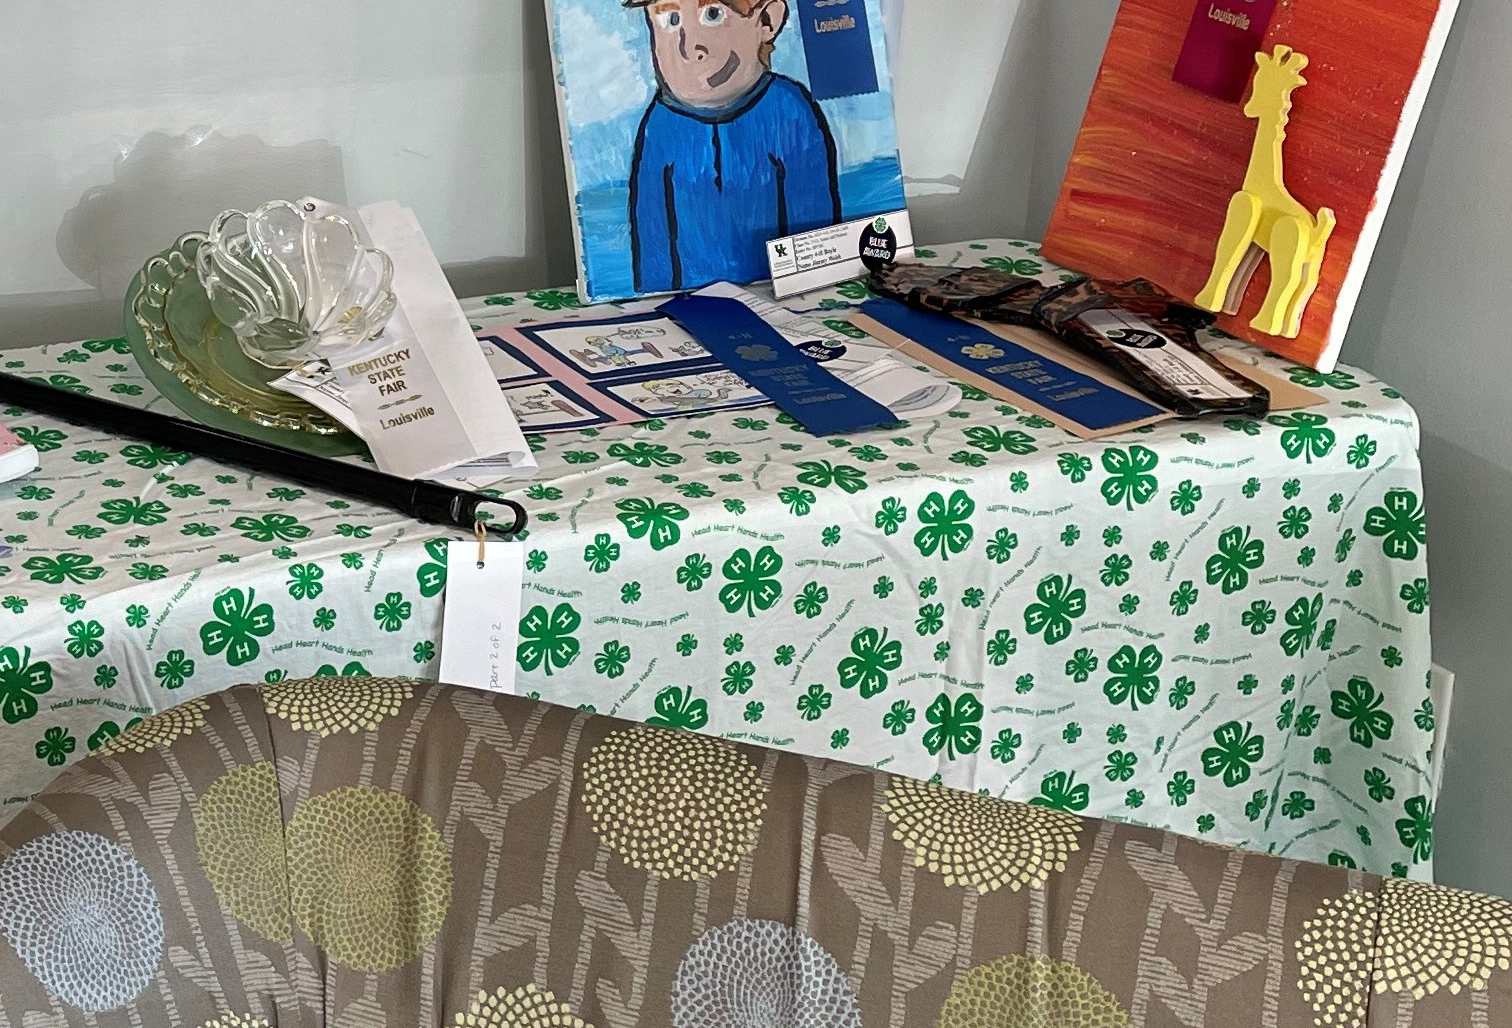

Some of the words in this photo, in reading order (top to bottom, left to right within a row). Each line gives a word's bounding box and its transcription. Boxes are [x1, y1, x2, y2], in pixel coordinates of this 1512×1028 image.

[814, 14, 855, 33] Louisville
[1207, 3, 1251, 31] Louisville
[869, 236, 888, 249] BLUE
[348, 348, 411, 377] KENTUCKY
[368, 365, 406, 385] STATE
[378, 380, 407, 397] FAIR
[379, 406, 435, 430] Louisville
